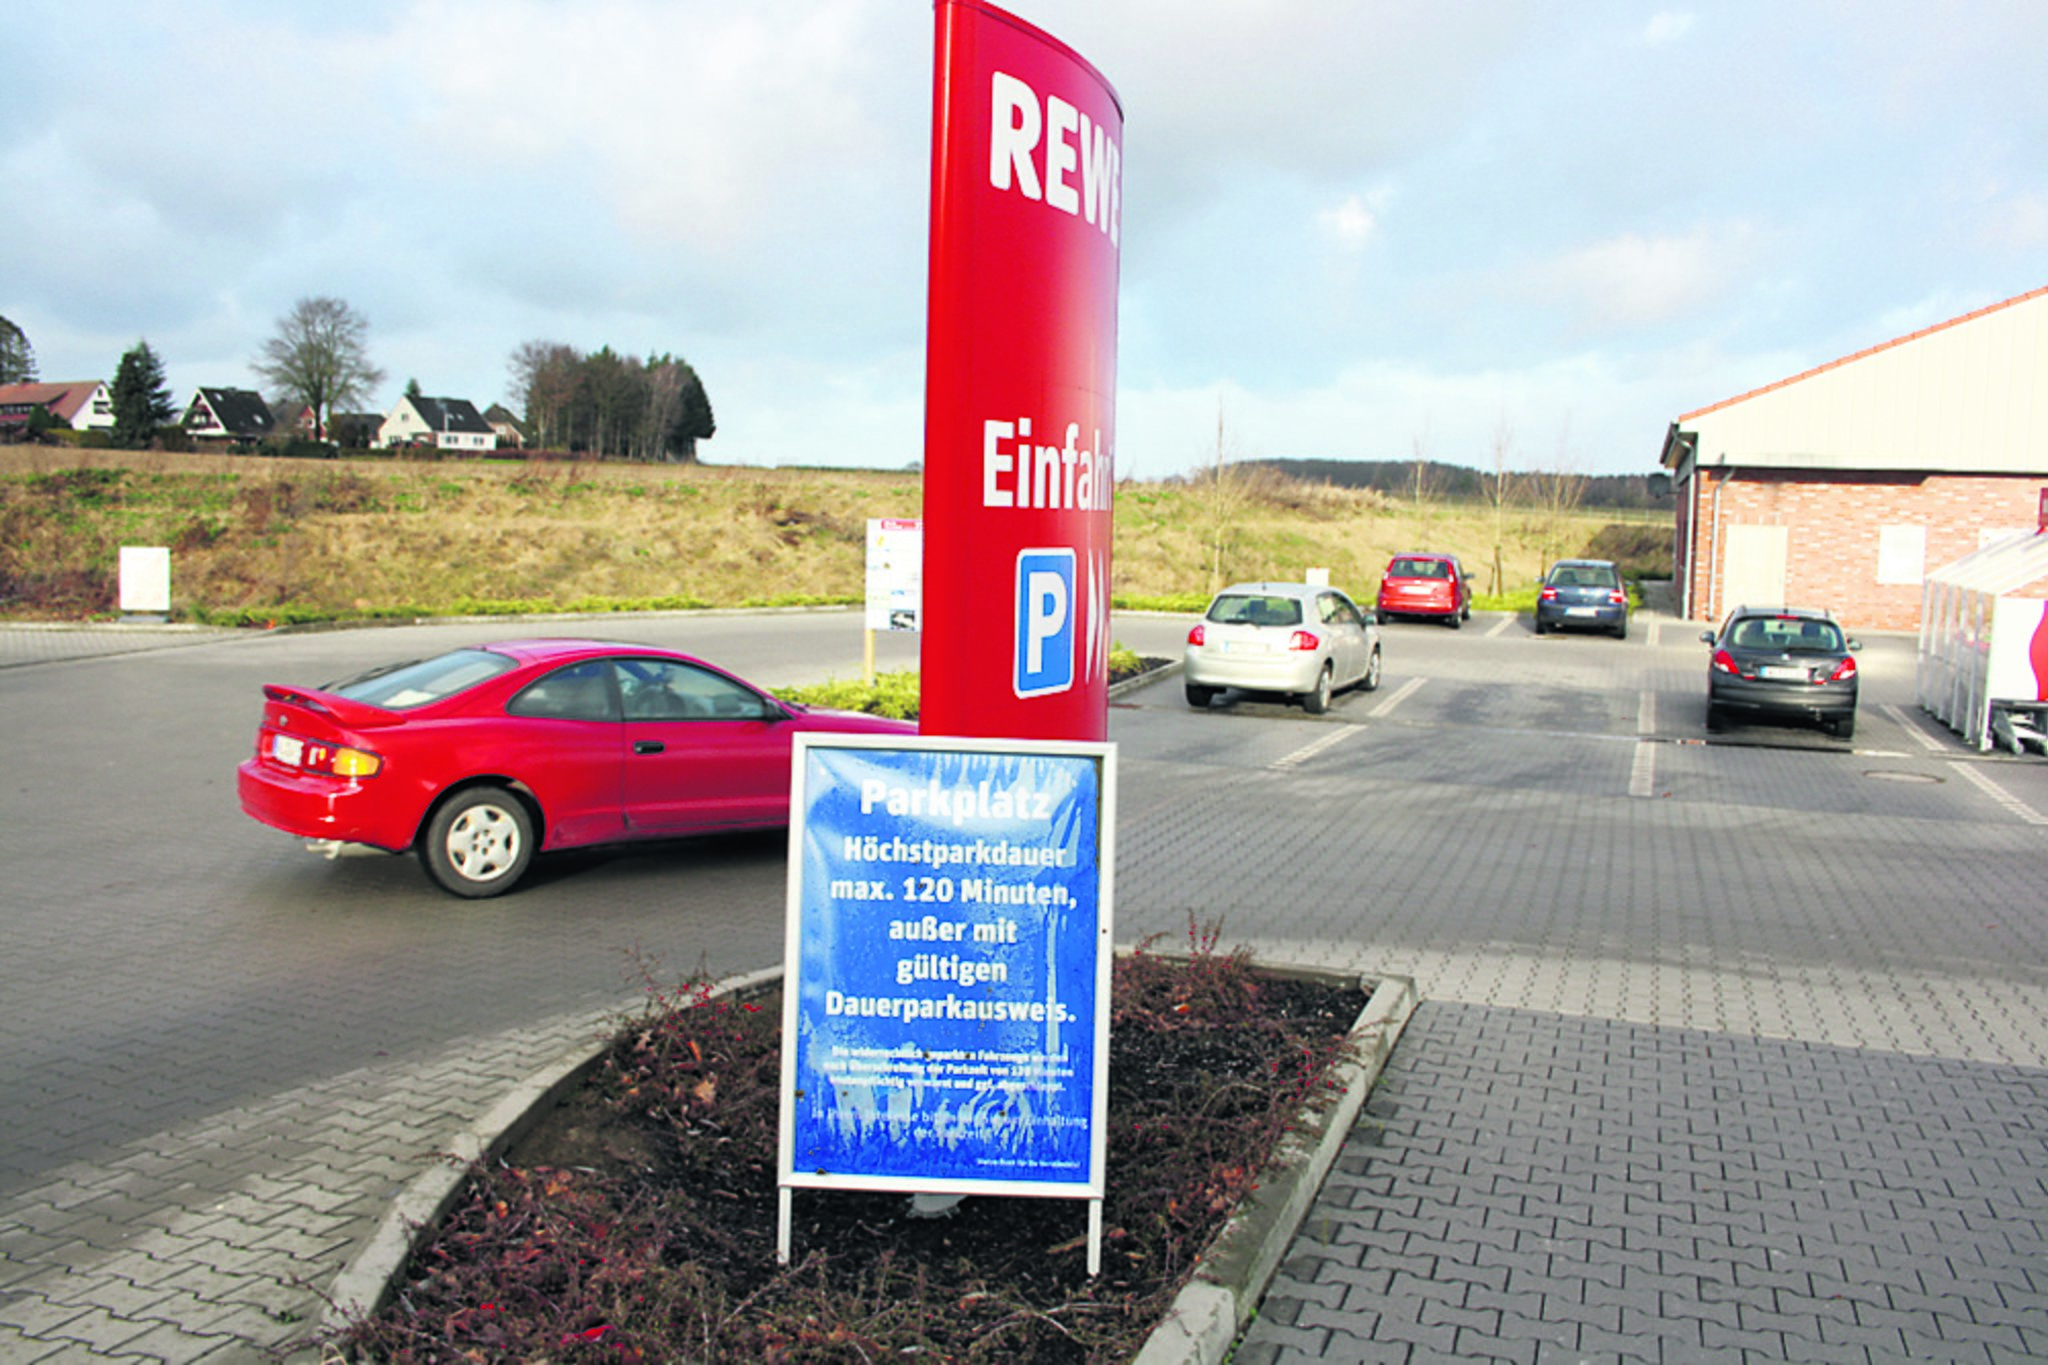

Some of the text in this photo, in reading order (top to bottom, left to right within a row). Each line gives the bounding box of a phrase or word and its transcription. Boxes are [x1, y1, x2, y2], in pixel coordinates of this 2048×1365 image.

[1027, 571, 1067, 674] P
[860, 778, 1051, 826] Parkplatz
[843, 836, 1067, 869] Höchstparkdauer
[830, 877, 1077, 909] max. 120 Minuten,
[889, 916, 1018, 943] außer mit
[896, 954, 1008, 986] gültigen
[825, 990, 1077, 1023] Dauerparkausweis.
